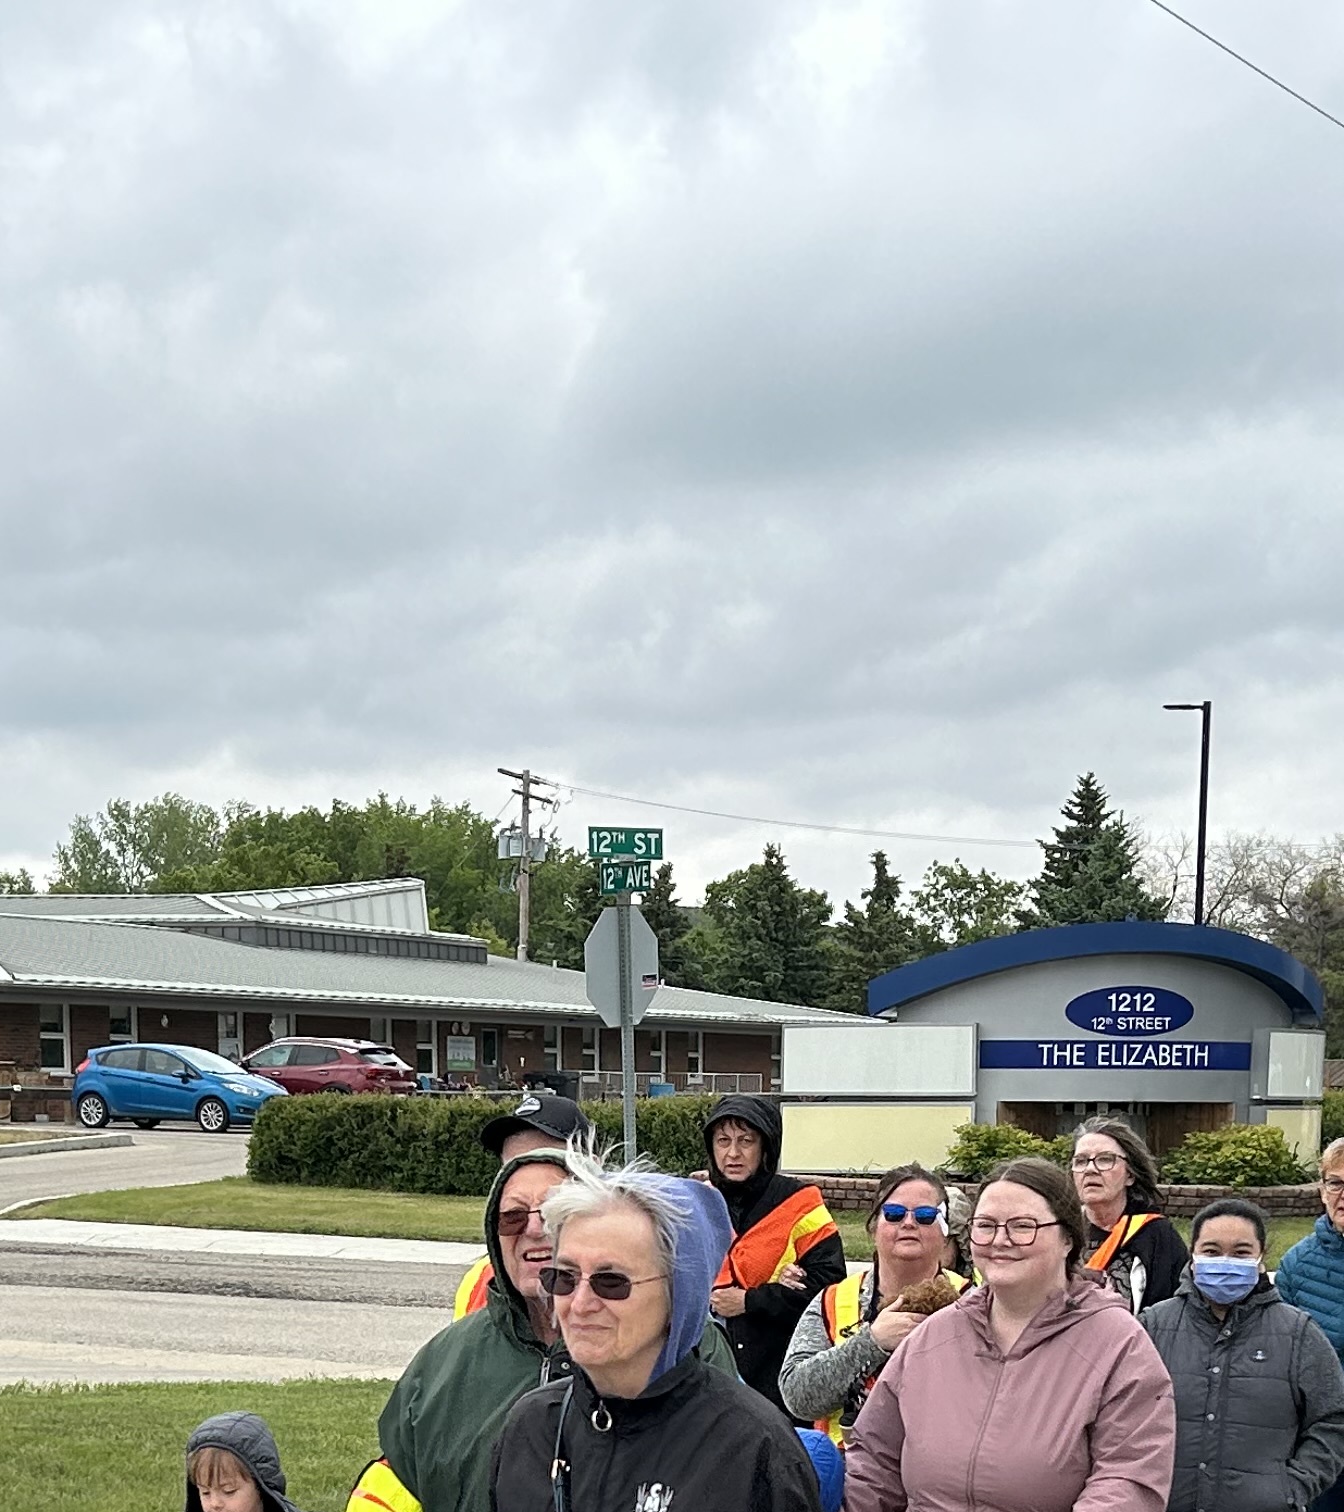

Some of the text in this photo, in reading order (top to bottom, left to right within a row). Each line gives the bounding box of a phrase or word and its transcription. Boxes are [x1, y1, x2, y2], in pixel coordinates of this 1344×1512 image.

[591, 831, 660, 855] 12TH ST
[625, 864, 650, 888] AVE
[1107, 992, 1156, 1012] 1212
[1116, 1016, 1172, 1030] STREET
[1038, 1043, 1210, 1067] THE ELIZABETH
